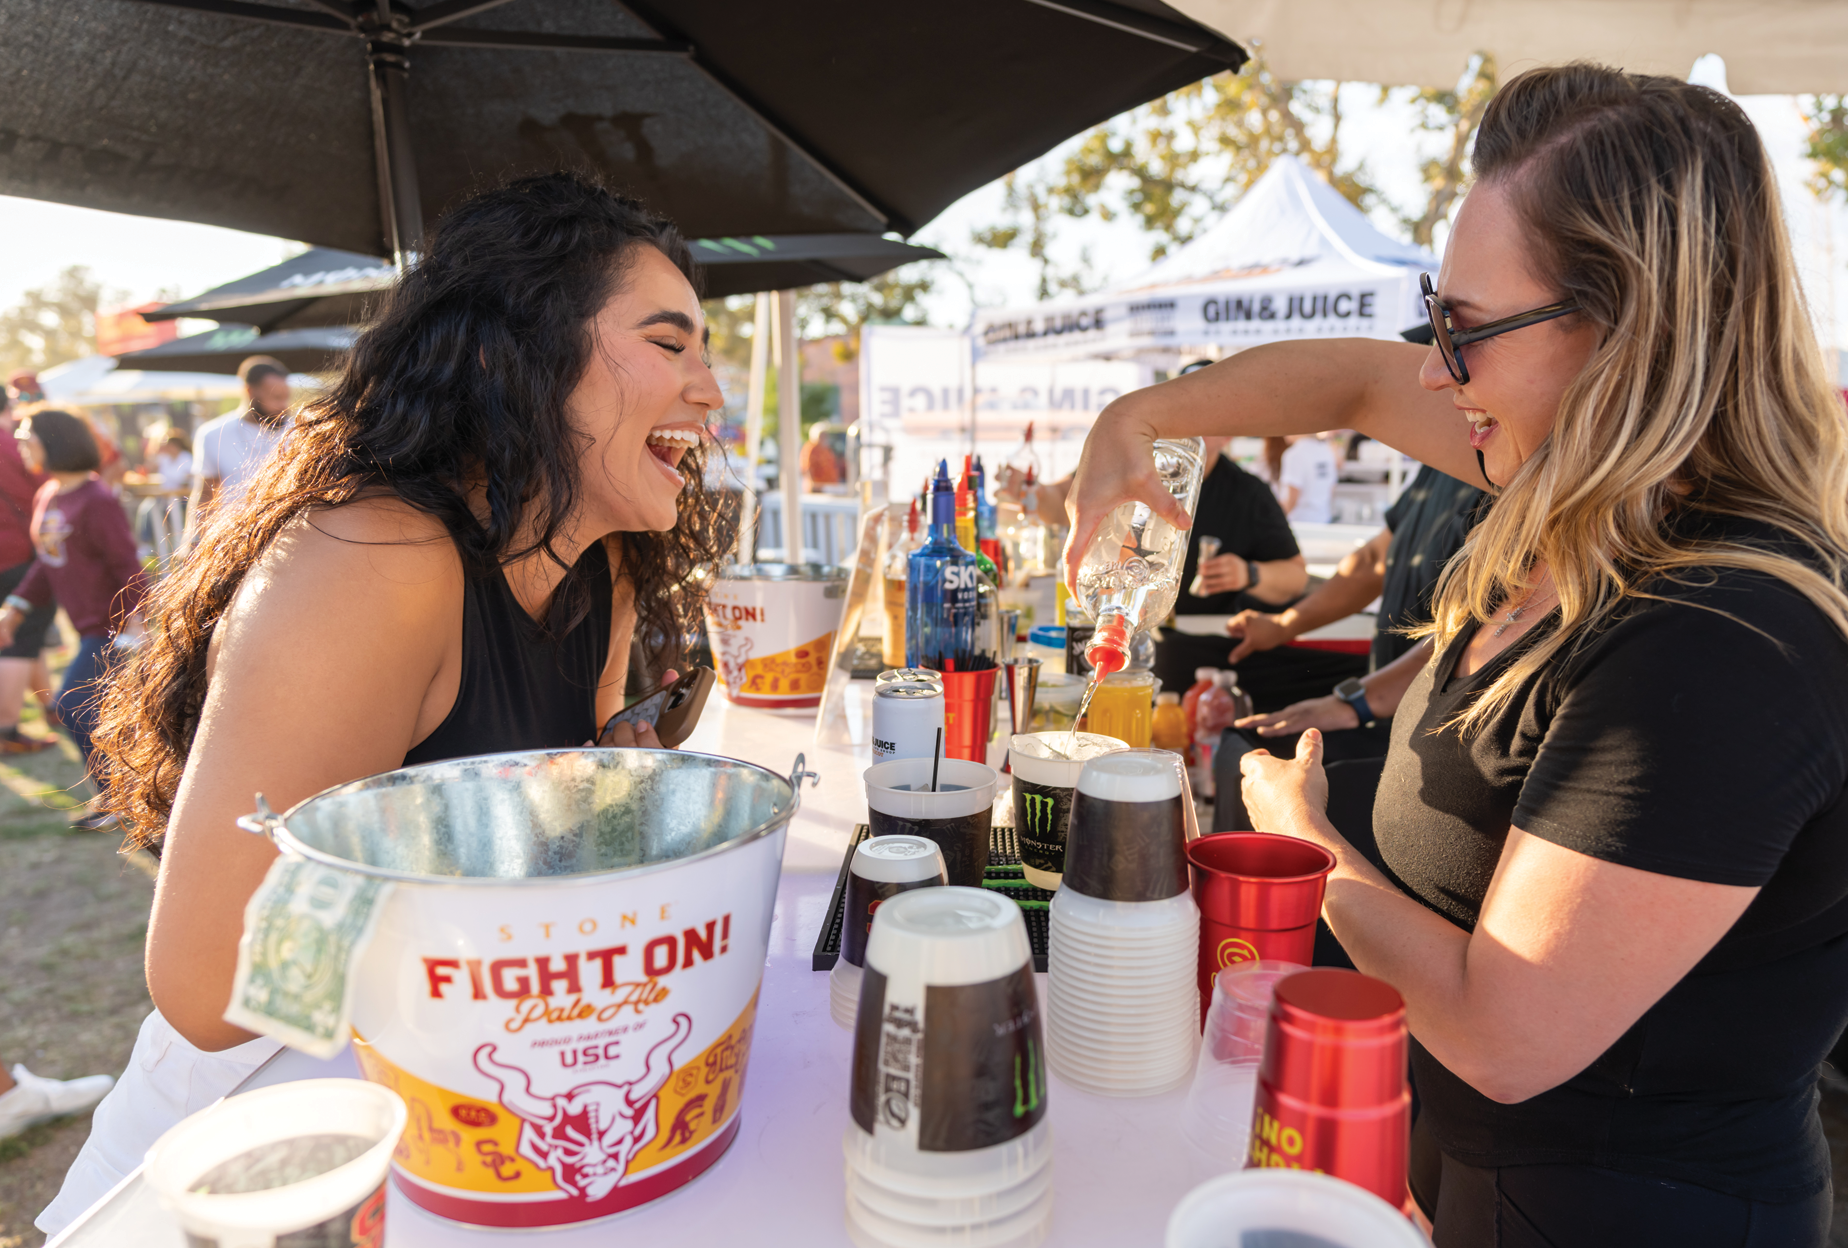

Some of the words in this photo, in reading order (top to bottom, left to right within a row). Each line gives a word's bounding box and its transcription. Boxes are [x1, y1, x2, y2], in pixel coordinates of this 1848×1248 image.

[1020, 836, 1063, 852] MONSTER
[499, 903, 672, 942] STONE
[422, 945, 628, 1001] FIGHT
[643, 913, 732, 979] ON!
[504, 993, 595, 1033] Pale
[597, 975, 670, 1022] Ale
[531, 1036, 573, 1049] PROUD
[577, 1025, 630, 1042] PARTNER
[632, 1019, 648, 1032] OF
[560, 1041, 620, 1068] USC
